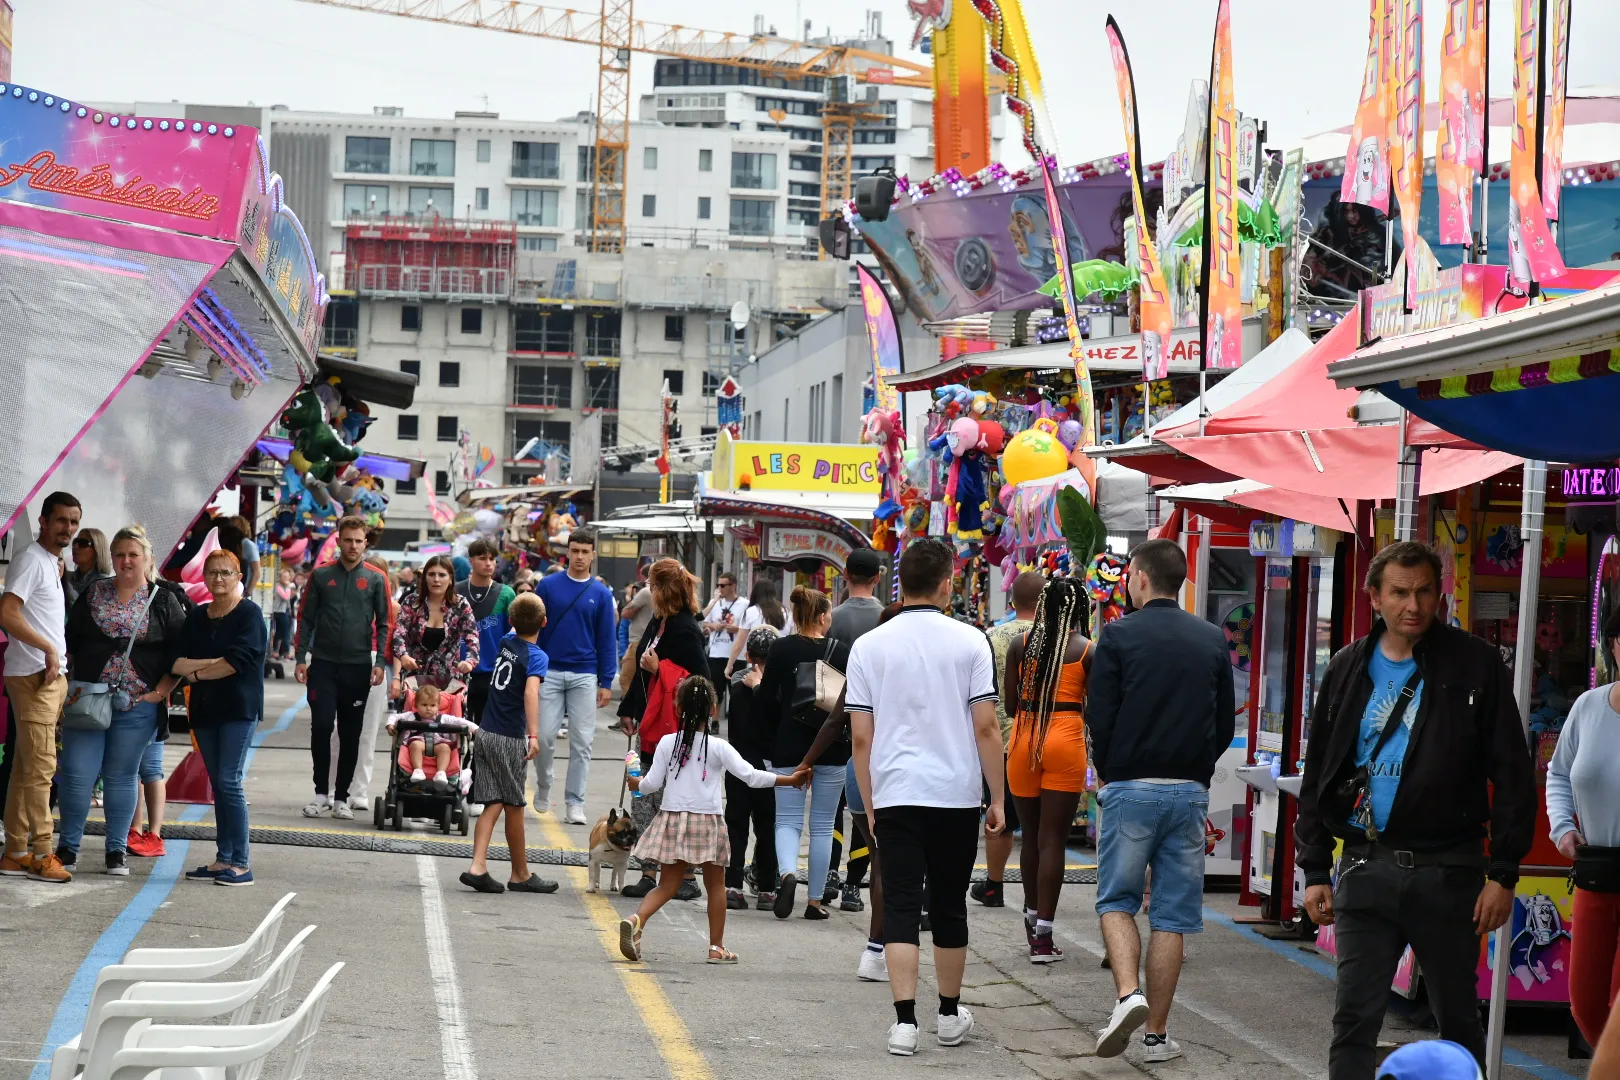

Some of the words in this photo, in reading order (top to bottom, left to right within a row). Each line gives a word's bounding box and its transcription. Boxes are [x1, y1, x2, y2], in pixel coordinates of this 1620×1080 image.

[9, 151, 219, 218] Américain
[1213, 116, 1235, 289] PINCE
[1068, 345, 1138, 360] HEZ
[752, 453, 801, 476] LES
[813, 459, 878, 483] PINC
[784, 534, 812, 549] THE
[501, 647, 519, 663] FRANCE
[490, 656, 513, 691] 10
